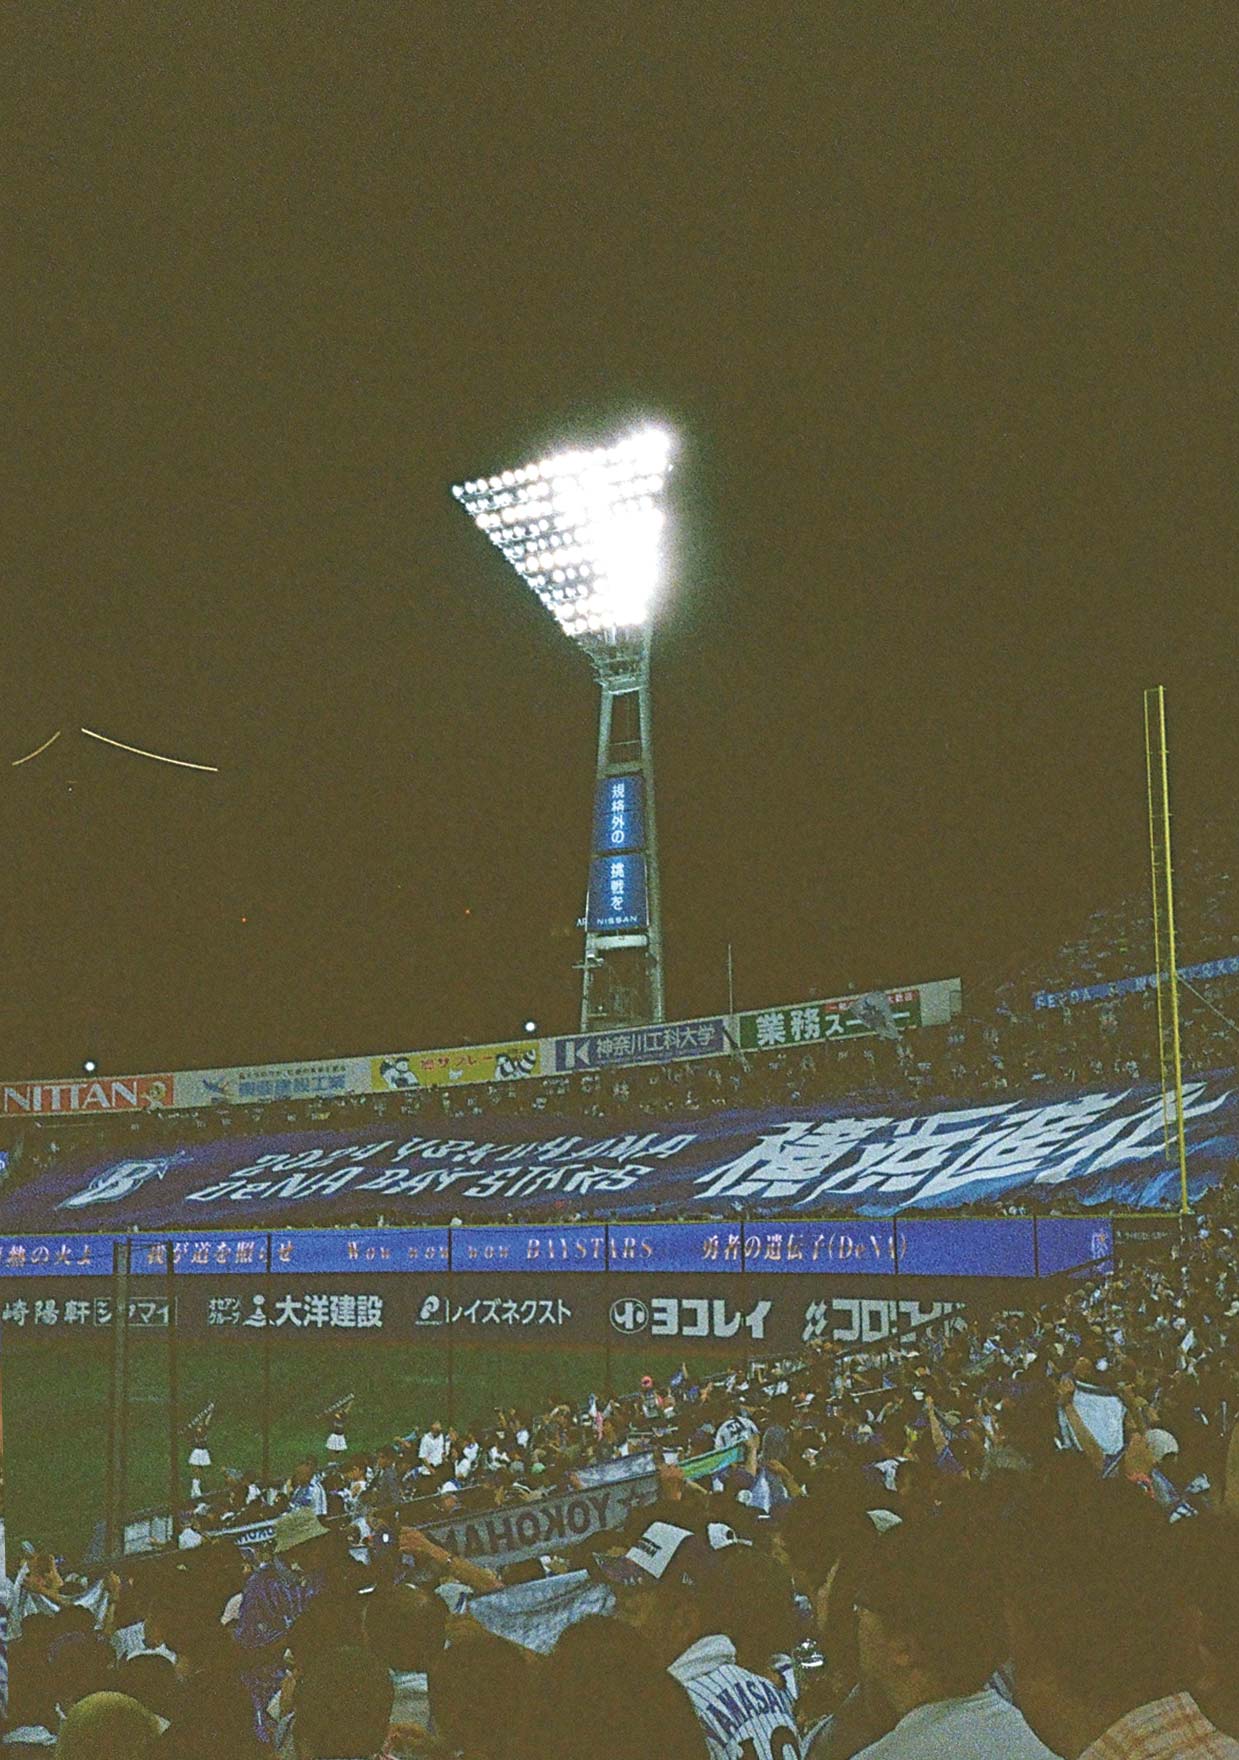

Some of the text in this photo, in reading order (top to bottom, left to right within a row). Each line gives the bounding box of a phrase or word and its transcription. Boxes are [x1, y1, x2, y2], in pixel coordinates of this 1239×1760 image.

[611, 784, 625, 843] 規格外の
[597, 915, 638, 925] NISSAN
[596, 1024, 715, 1058] 神奈川工科大学
[756, 1008, 911, 1045] 業務スーー
[4, 1081, 138, 1112] NITTAN
[392, 1132, 698, 1164] YOKOHAMA
[185, 1167, 365, 1201] DeNA
[0, 1244, 91, 1268] 熱の火よ
[527, 1237, 653, 1260] BAYSTARS
[2, 1298, 91, 1327] 崎陽軒
[275, 1294, 383, 1328] 大洋建設
[445, 1297, 572, 1325] レイズネクスト
[651, 1298, 772, 1339] ヨコレイ
